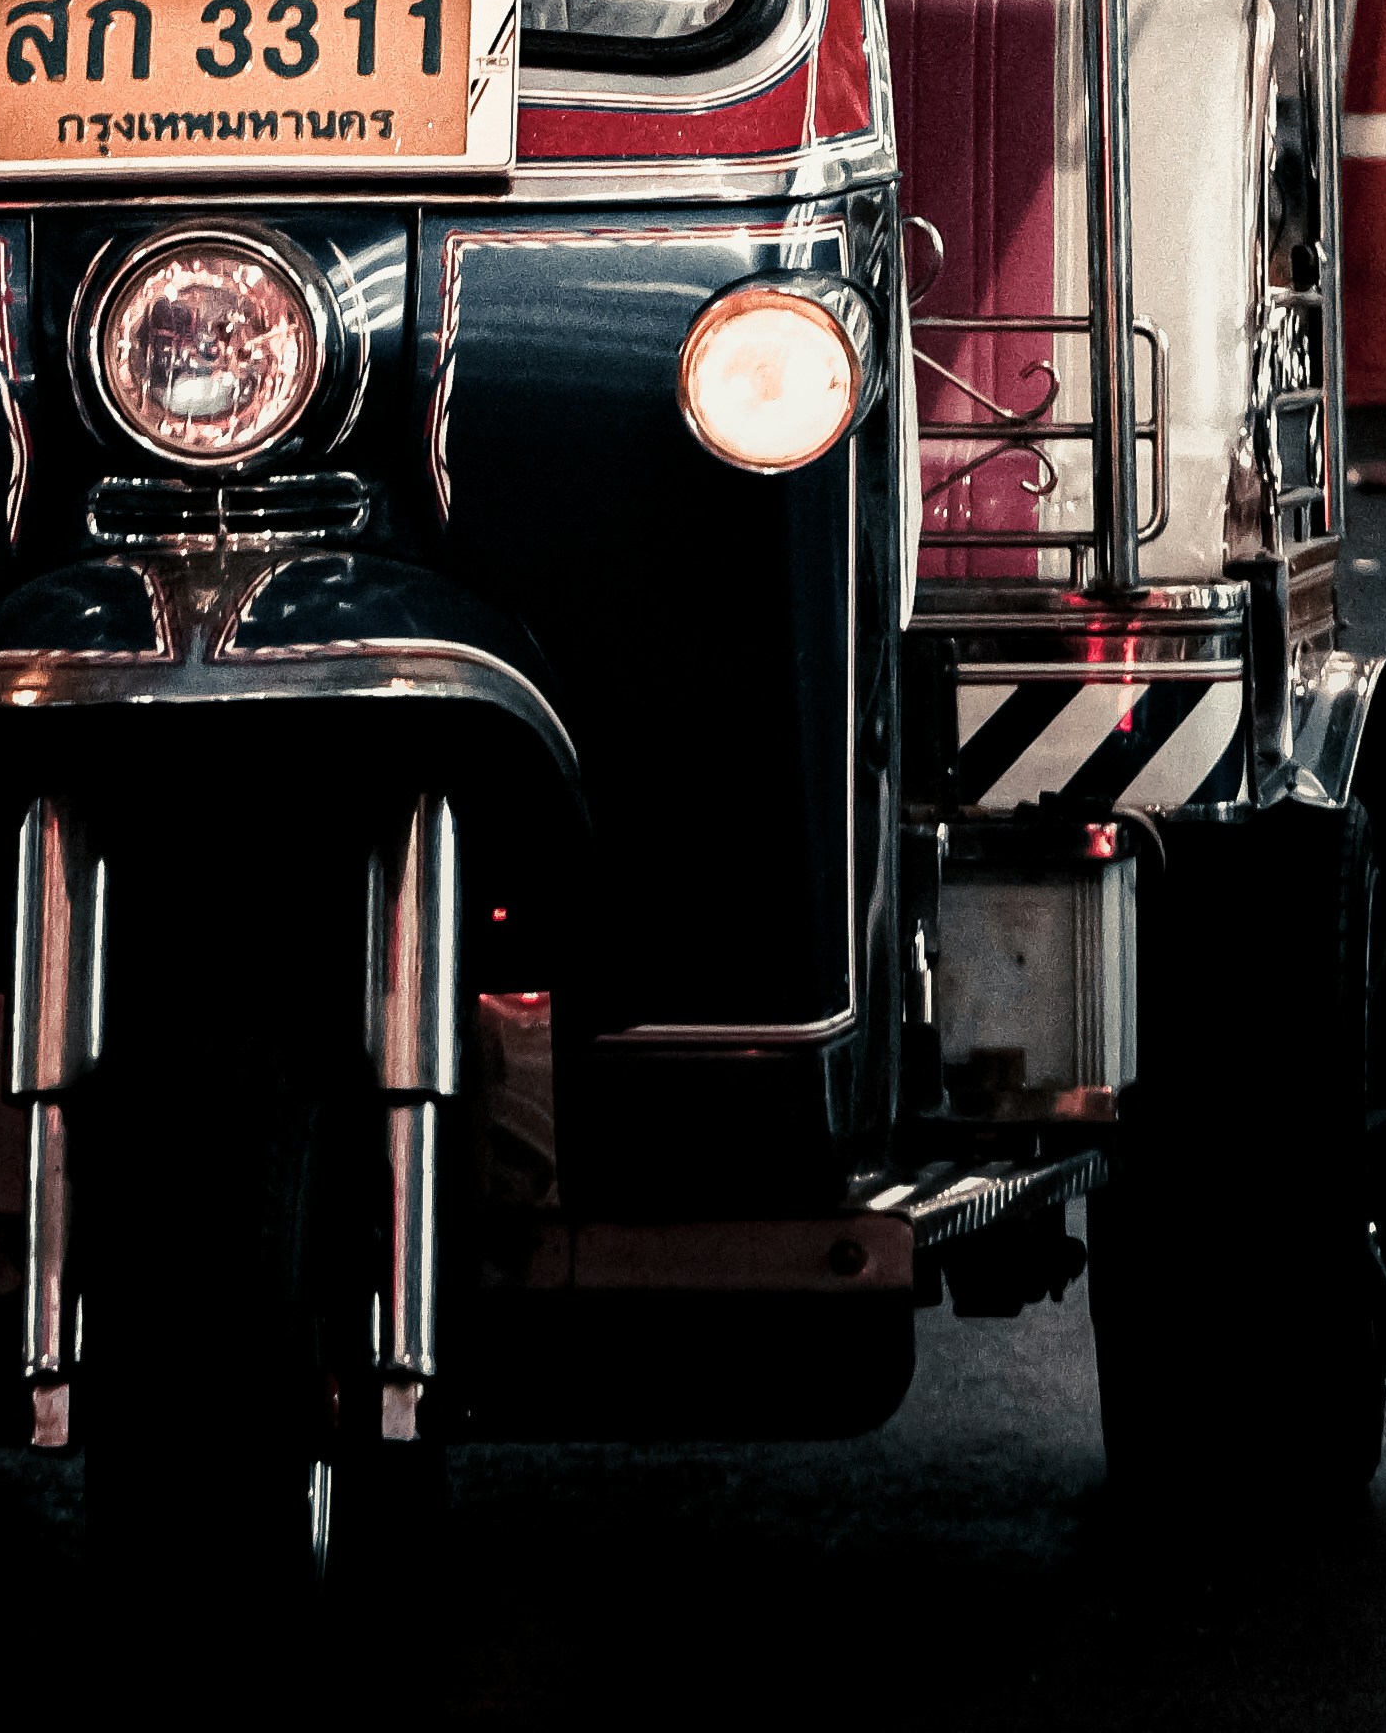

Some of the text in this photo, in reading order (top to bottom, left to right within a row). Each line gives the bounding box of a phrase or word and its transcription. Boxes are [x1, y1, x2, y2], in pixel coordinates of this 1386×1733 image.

[56, 107, 396, 156] กรุงเทพมหานคร
